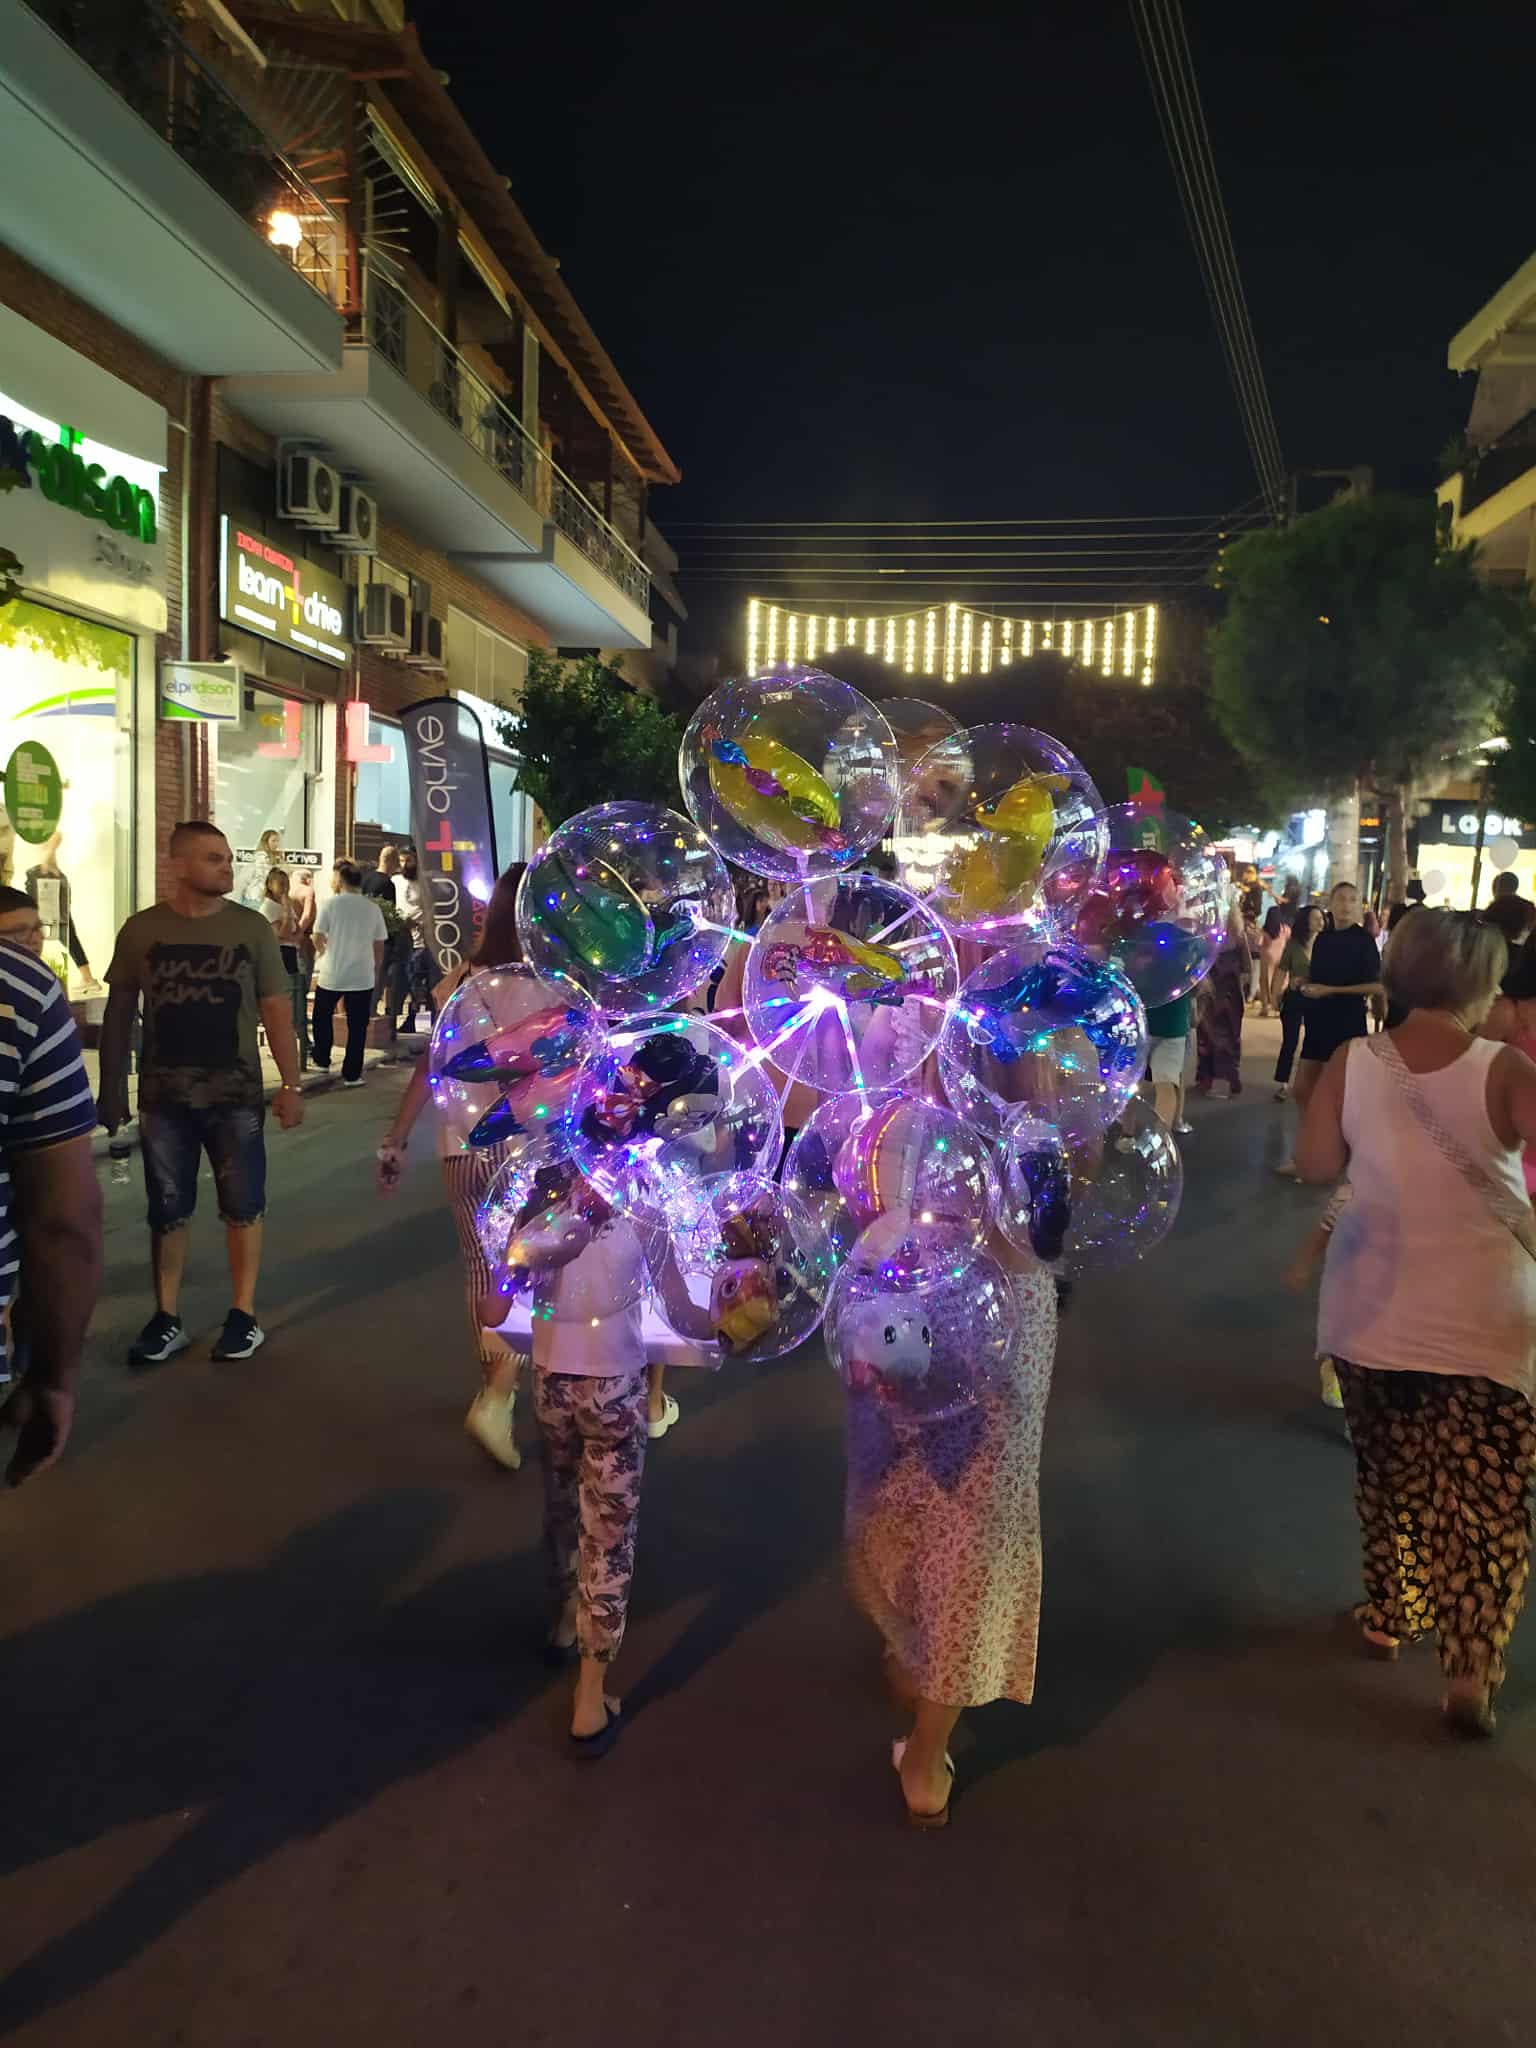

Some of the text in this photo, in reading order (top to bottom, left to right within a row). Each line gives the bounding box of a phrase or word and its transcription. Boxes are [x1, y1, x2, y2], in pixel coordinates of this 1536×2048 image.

[304, 591, 343, 636] drive
[1441, 813, 1523, 836] LOOK
[286, 852, 318, 865] drive
